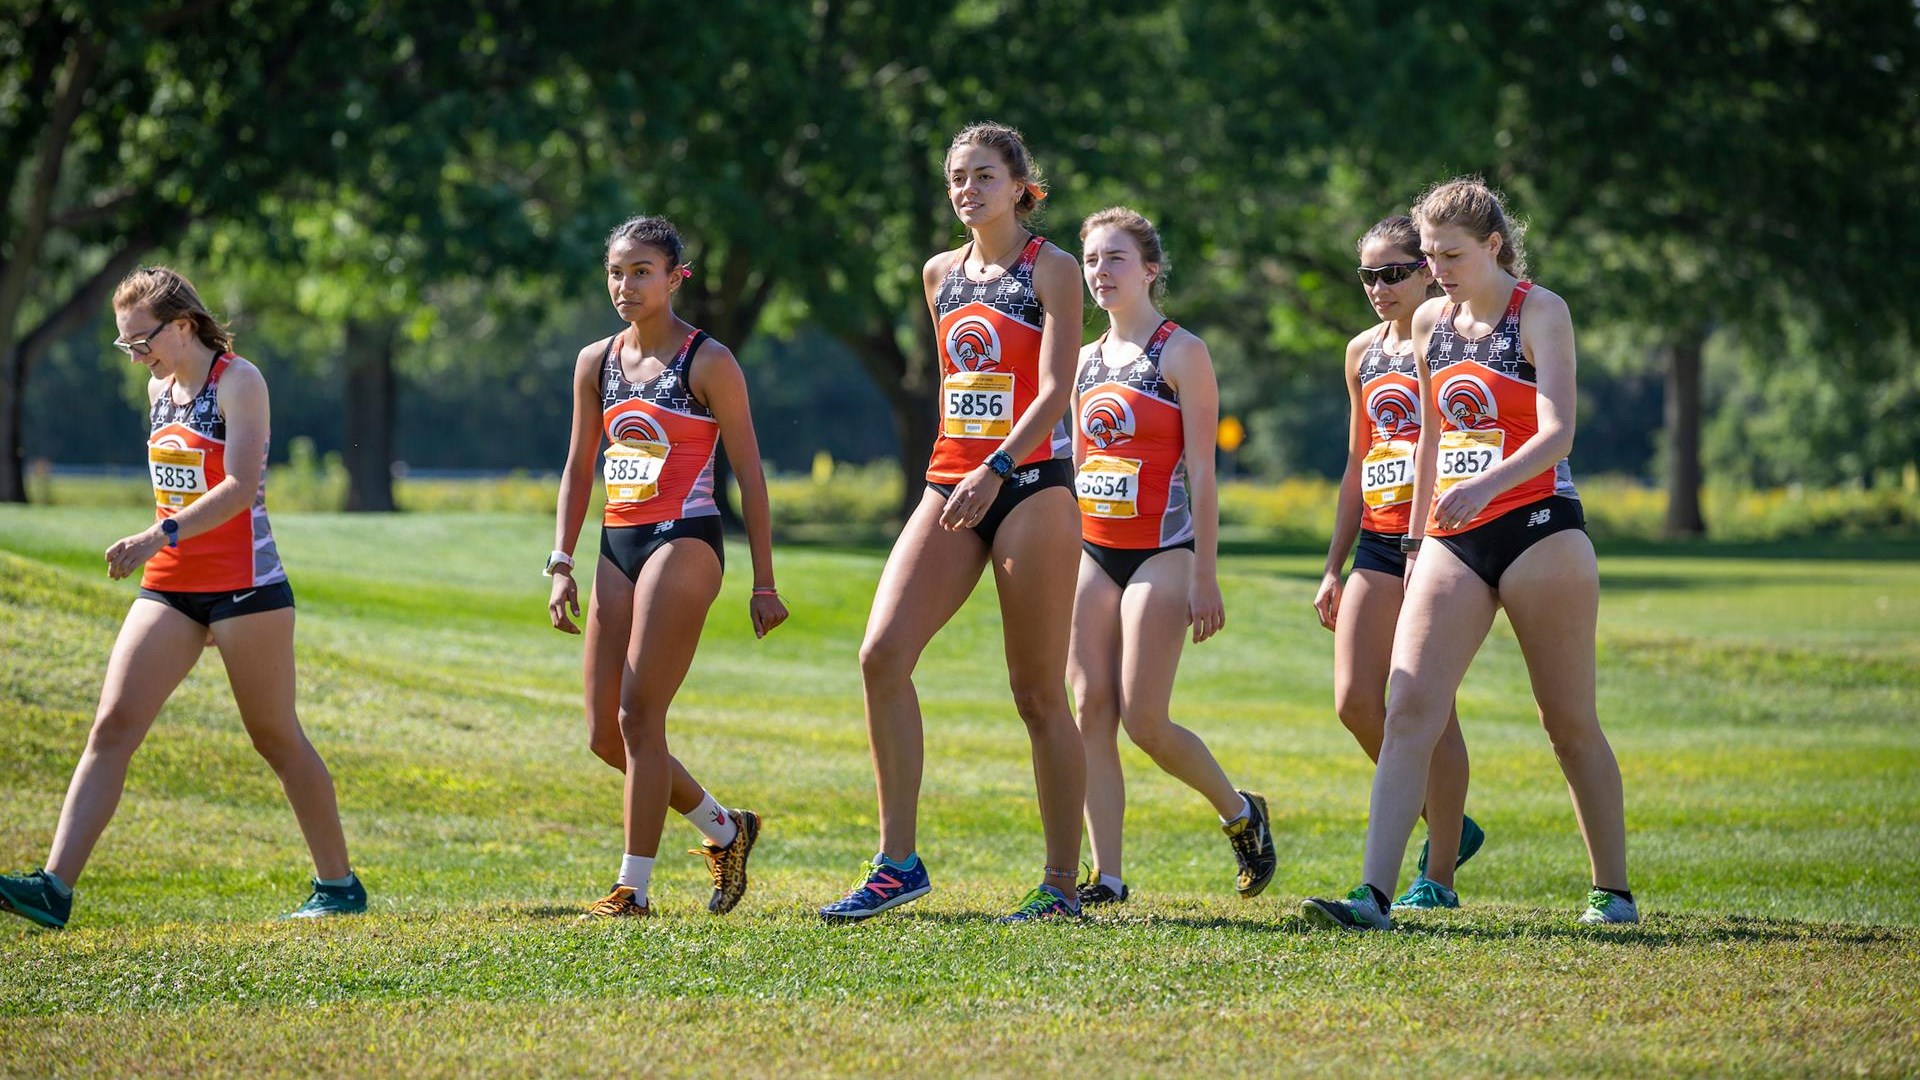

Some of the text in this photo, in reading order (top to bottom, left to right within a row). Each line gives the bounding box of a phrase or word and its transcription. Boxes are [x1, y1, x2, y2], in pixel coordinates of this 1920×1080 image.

[950, 393, 1003, 417] 5856
[609, 459, 651, 481] 5851
[1367, 460, 1406, 487] 5857
[1443, 450, 1492, 474] 5852
[155, 466, 197, 490] 5853
[1081, 475, 1129, 497] 5854
